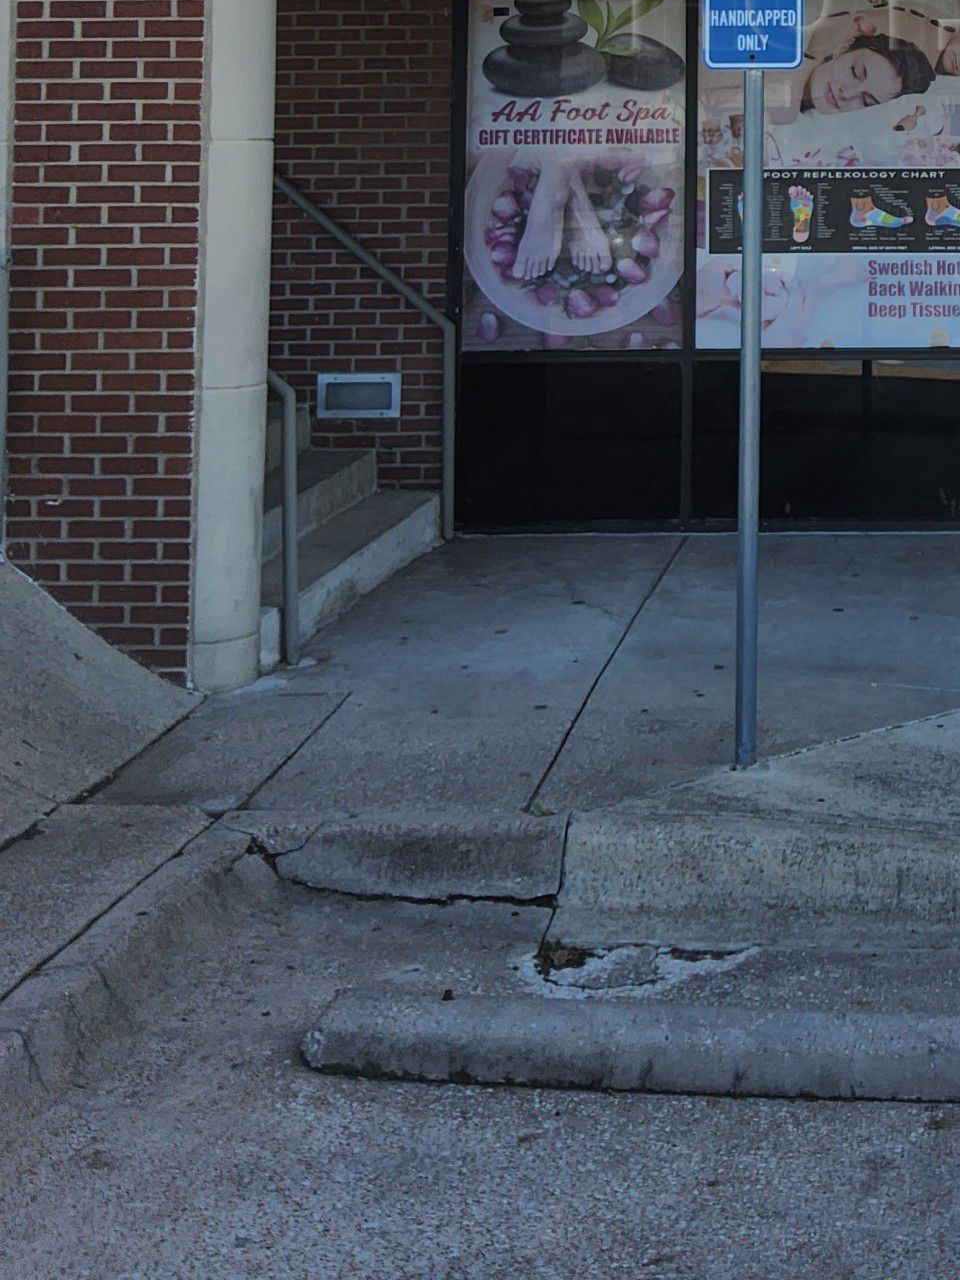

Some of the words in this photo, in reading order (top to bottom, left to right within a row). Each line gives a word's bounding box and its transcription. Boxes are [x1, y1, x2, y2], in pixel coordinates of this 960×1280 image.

[710, 9, 796, 27] HANDICAPPED
[737, 34, 769, 52] ONLY
[491, 100, 542, 122] AA
[550, 99, 611, 122] Foot
[616, 99, 672, 126] Spa
[479, 129, 510, 145] GIFT
[513, 128, 602, 145] CERTIFICATE
[605, 128, 680, 144] AVAILABLE
[763, 171, 798, 179] FOOT
[803, 171, 896, 179] REFLEXOLOGY
[901, 171, 946, 179] CHART
[868, 260, 933, 276] Swedish
[868, 281, 906, 296] Back
[868, 302, 906, 319] Deep
[911, 302, 960, 318] Tissue
